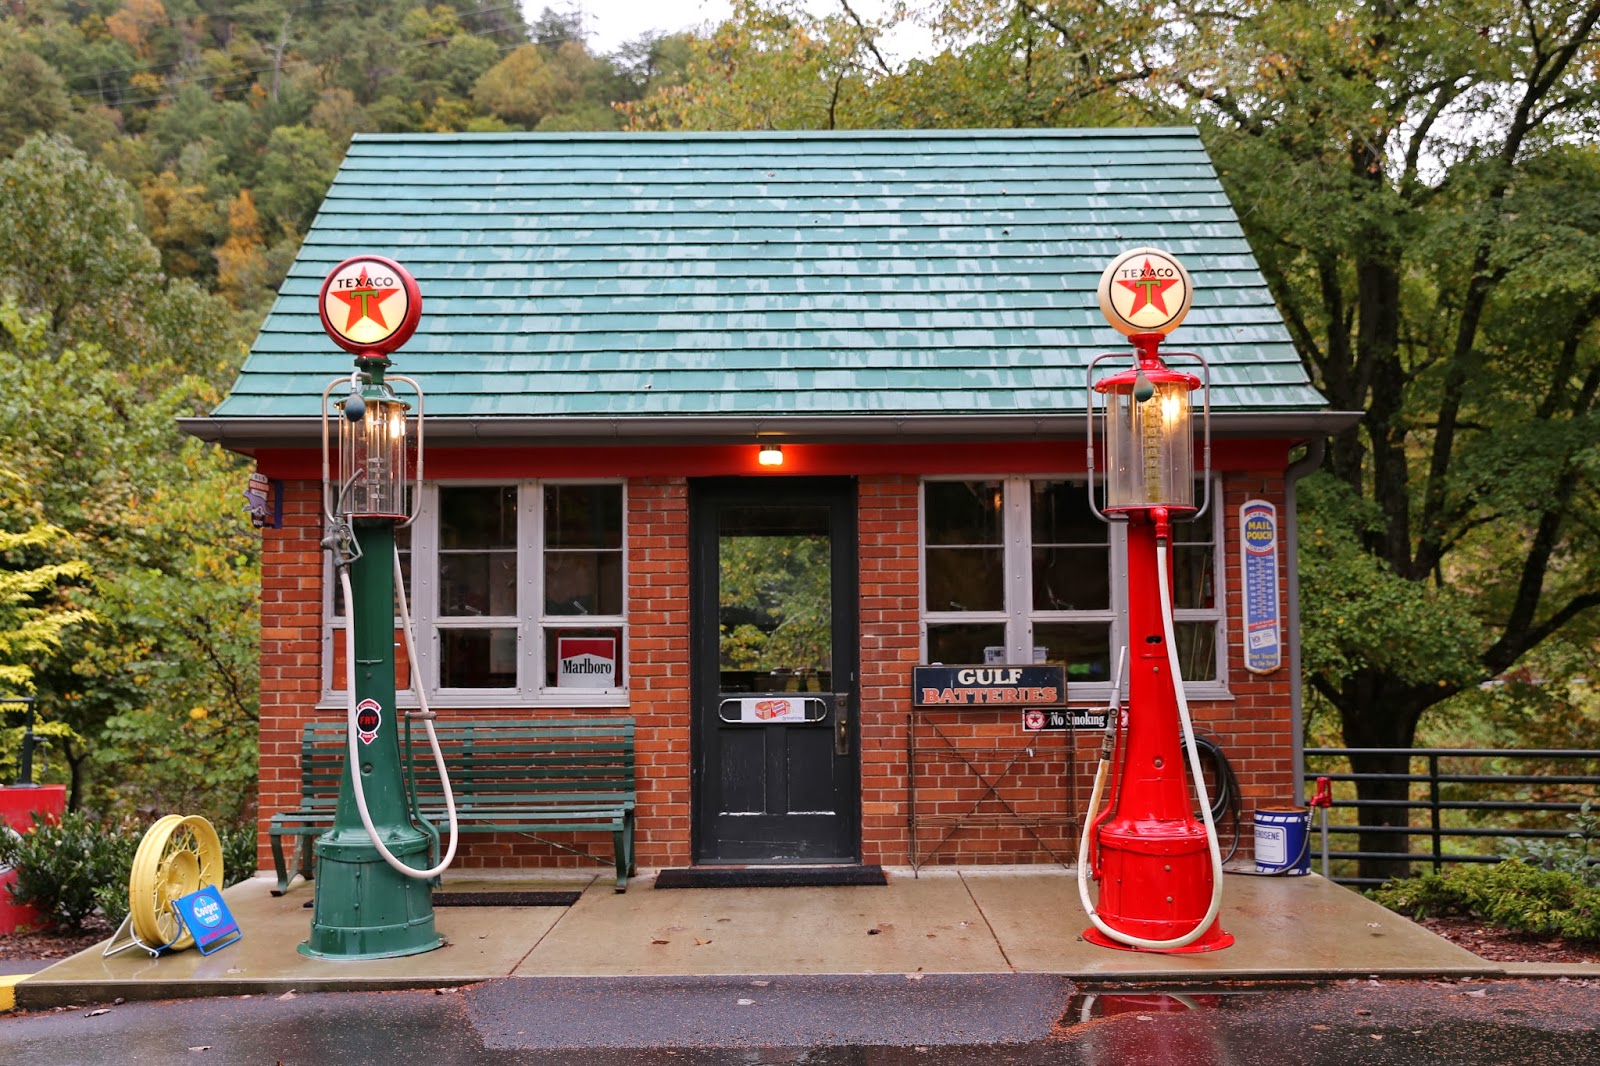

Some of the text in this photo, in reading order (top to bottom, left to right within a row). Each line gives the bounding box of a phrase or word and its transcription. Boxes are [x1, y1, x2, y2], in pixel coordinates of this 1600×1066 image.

[1122, 268, 1173, 278] TEXACO
[337, 277, 393, 288] TEXACO
[1135, 280, 1162, 304] T
[350, 289, 379, 317] T
[1248, 522, 1272, 530] MAIL
[1247, 531, 1272, 540] POUCH
[563, 658, 612, 674] Marlboro
[957, 669, 1023, 685] GULF
[922, 687, 1058, 704] BATTERIES
[359, 715, 377, 725] FRY
[1051, 712, 1105, 728] No Smoking
[1255, 830, 1280, 840] EROSENE
[194, 902, 219, 918] Cooper
